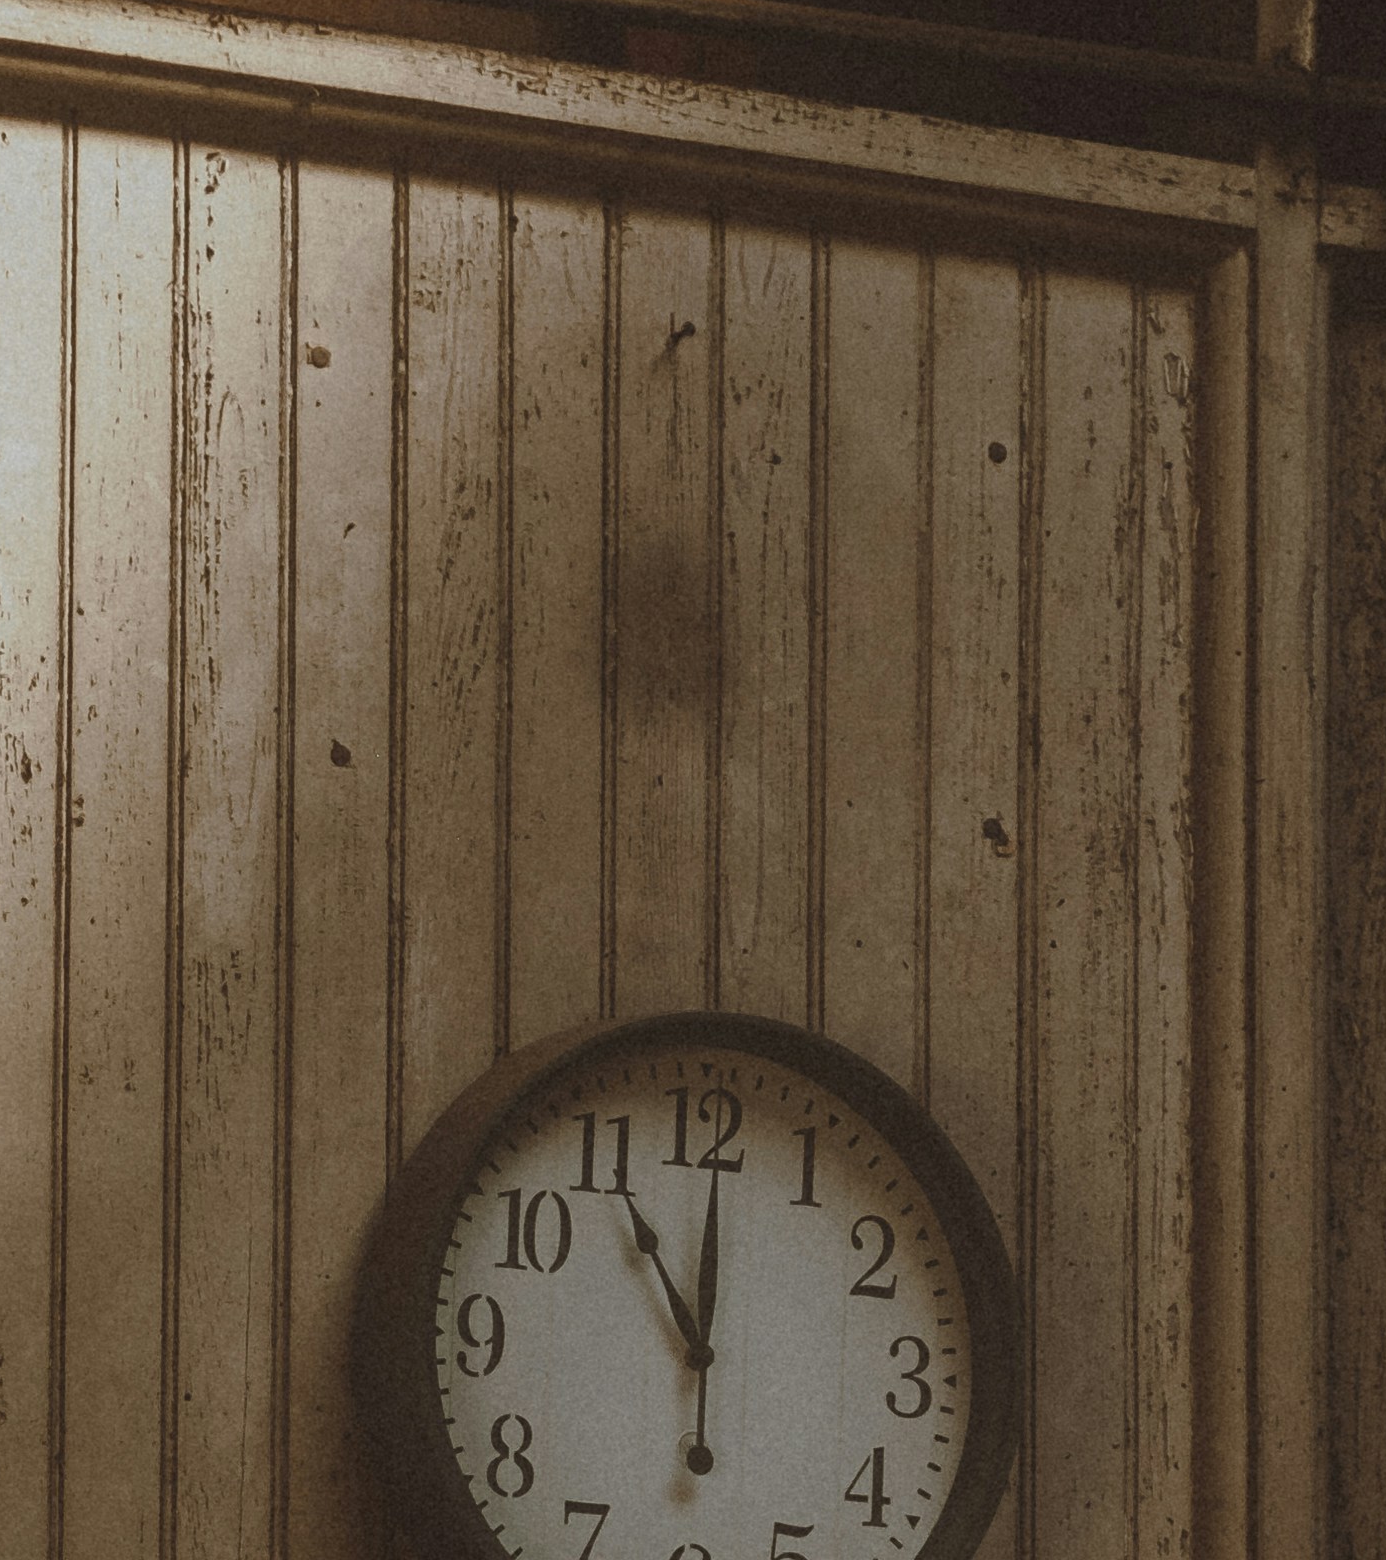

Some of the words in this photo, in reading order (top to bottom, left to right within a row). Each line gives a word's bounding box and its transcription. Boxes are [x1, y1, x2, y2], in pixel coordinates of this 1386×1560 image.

[570, 1111, 636, 1197] 11
[662, 1086, 745, 1173] 12
[789, 1125, 822, 1208] 1
[495, 1187, 572, 1273] 10
[849, 1216, 898, 1300] 2
[456, 1293, 506, 1378] 9
[886, 1335, 933, 1419] 3
[486, 1414, 535, 1498] 8
[844, 1447, 891, 1528] 4
